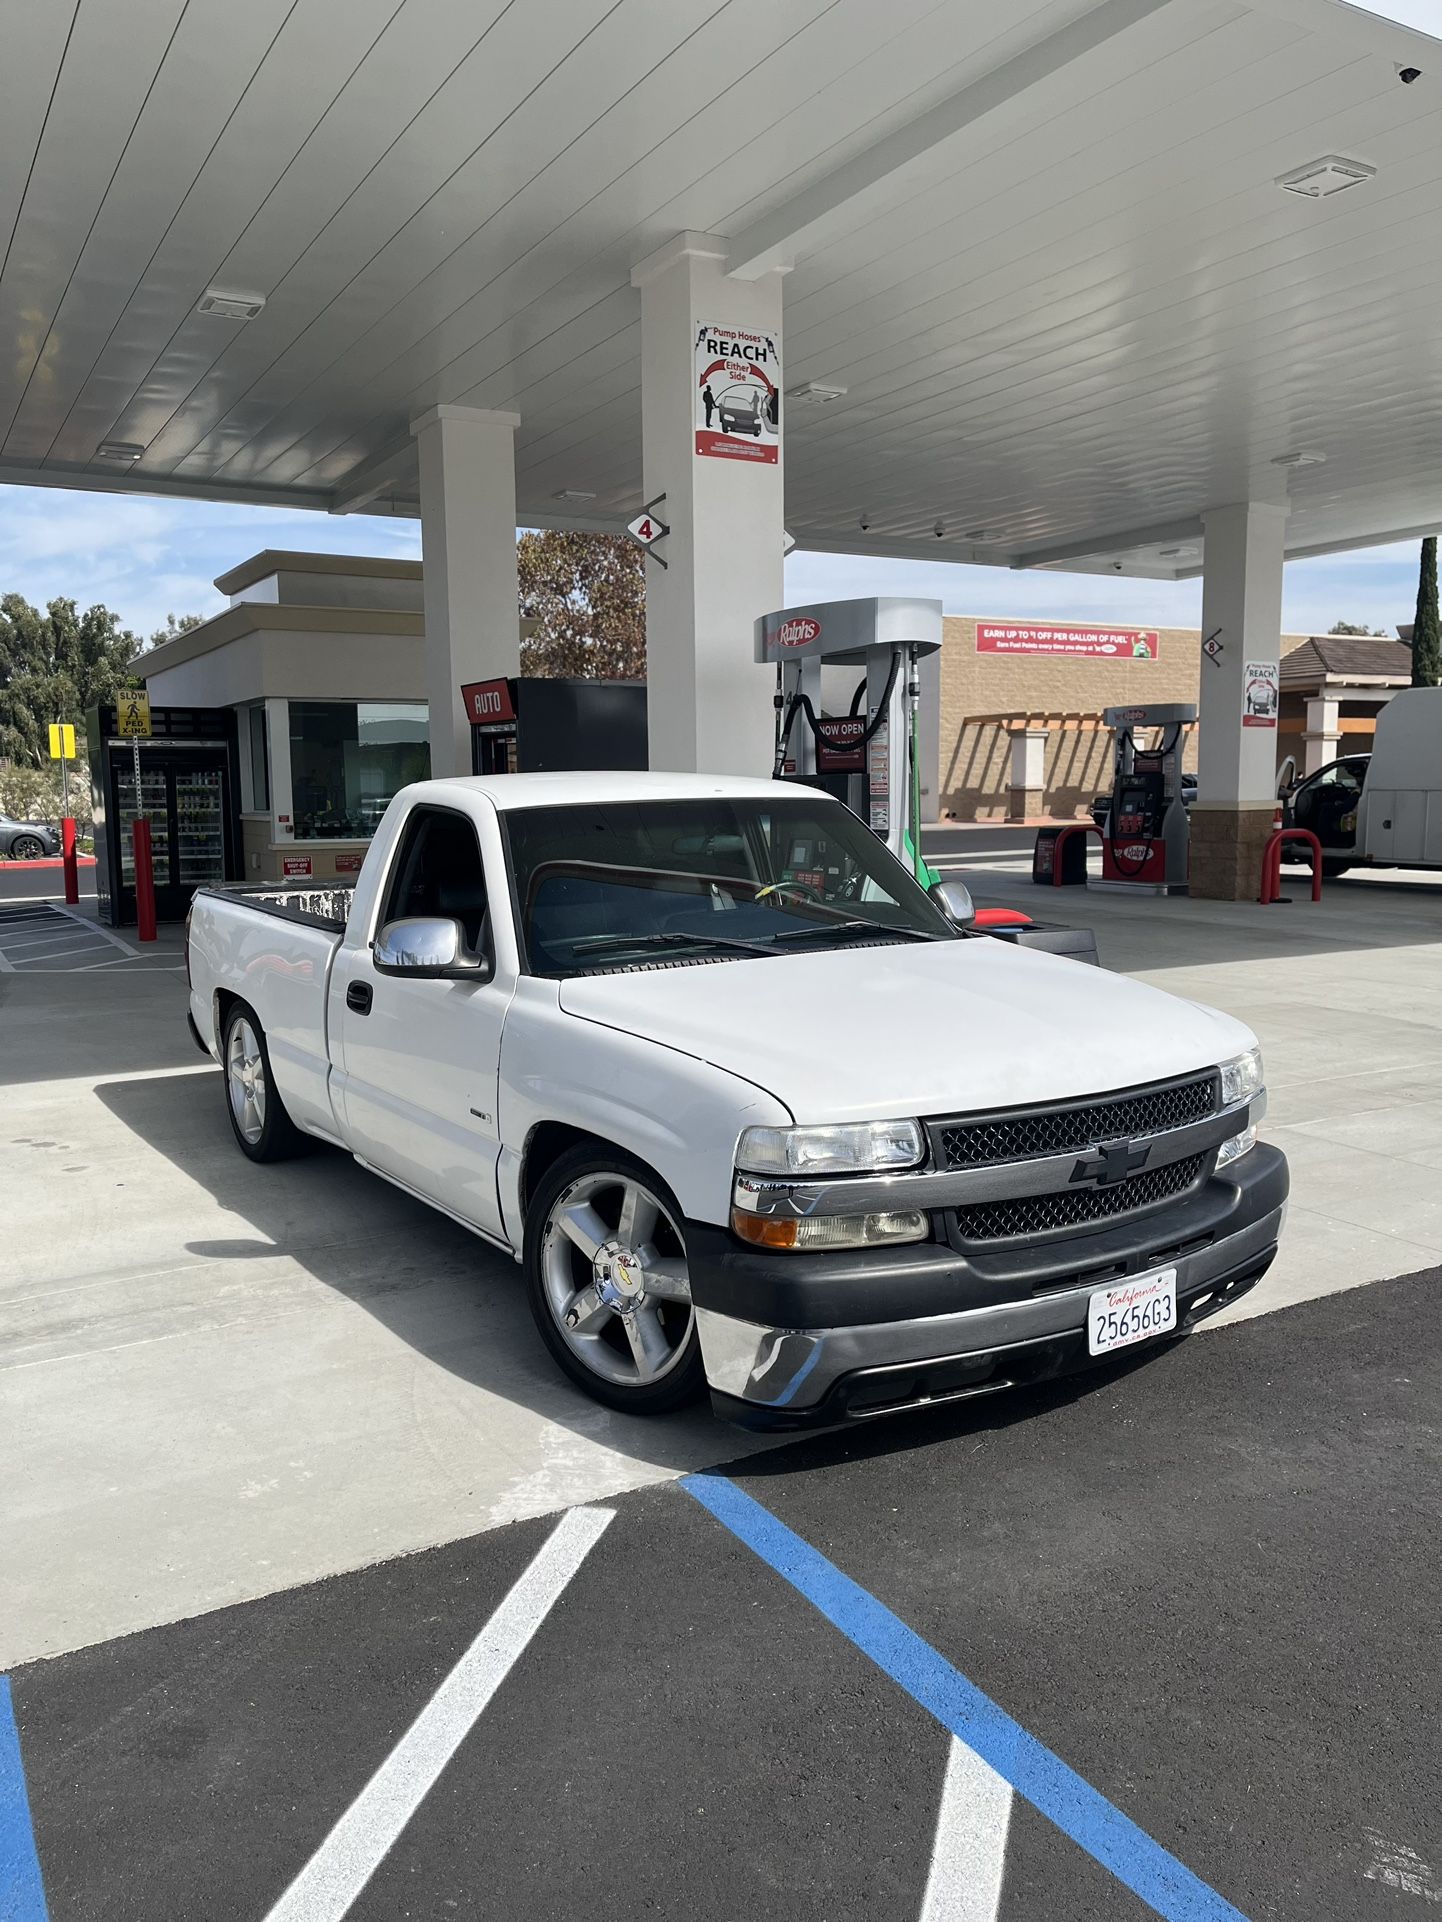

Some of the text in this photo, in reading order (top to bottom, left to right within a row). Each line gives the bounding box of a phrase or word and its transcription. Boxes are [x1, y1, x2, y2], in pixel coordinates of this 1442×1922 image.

[713, 327, 761, 343] Pump Hoses
[707, 339, 767, 363] REACH
[726, 361, 749, 372] Either
[729, 371, 746, 381] Side
[638, 519, 653, 539] 4
[780, 620, 816, 646] Ralphs
[984, 629, 1005, 638] EARN
[1006, 630, 1017, 639] UP
[1018, 631, 1029, 639] TO
[1037, 631, 1052, 640] OFF
[1053, 632, 1067, 640] PER
[1069, 633, 1097, 642] GALLON
[1099, 634, 1108, 643] OF
[1208, 642, 1215, 652] 8
[1249, 669, 1274, 678] REACH
[120, 691, 146, 700] SLOW
[785, 691, 793, 705] 4
[474, 691, 501, 715] AUTO
[819, 723, 864, 736] NOW OPEN
[1109, 1285, 1161, 1307] California
[1097, 1295, 1171, 1344] 25656G3
